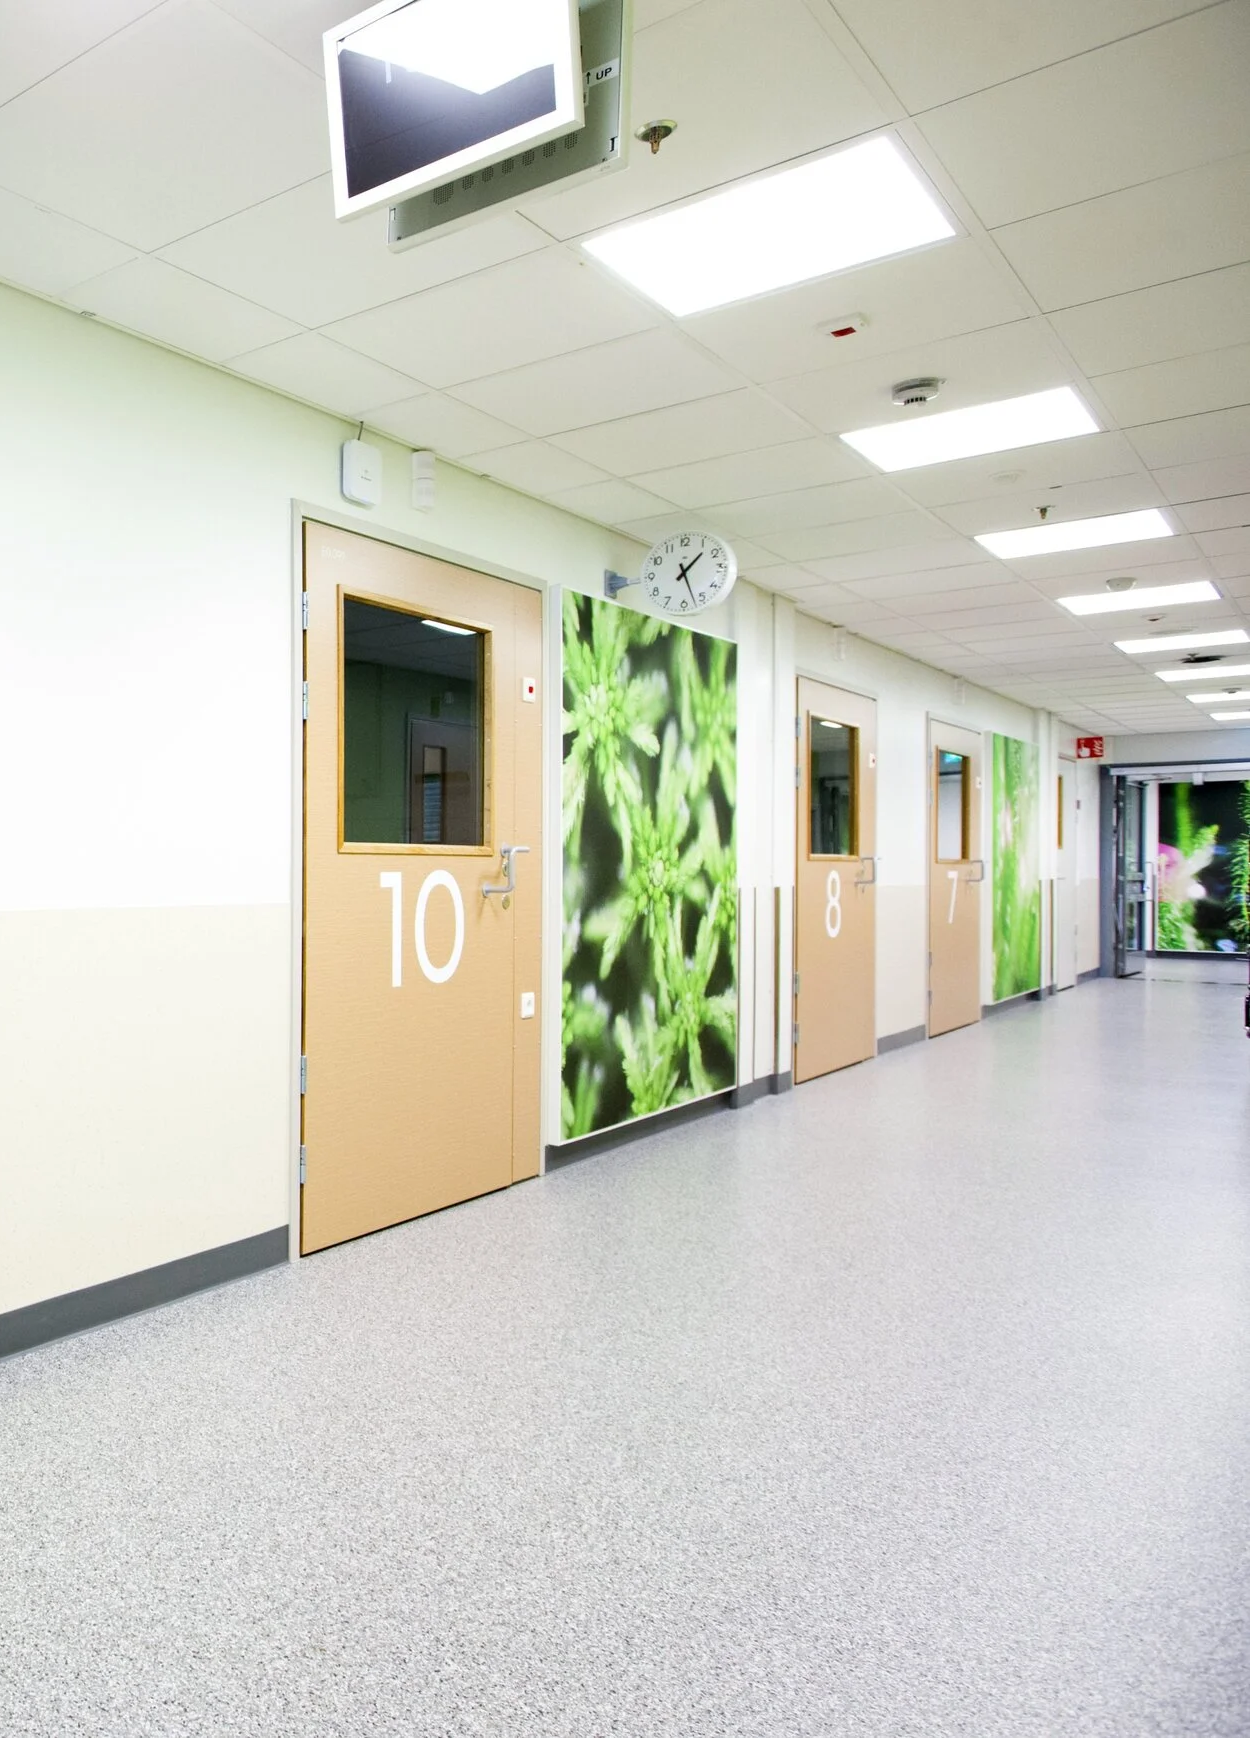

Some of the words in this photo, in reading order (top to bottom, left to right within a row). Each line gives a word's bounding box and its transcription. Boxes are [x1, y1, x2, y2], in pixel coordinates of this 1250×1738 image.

[596, 67, 612, 80] UP
[680, 537, 690, 547] 12
[701, 539, 705, 548] 1
[665, 544, 674, 554] 11
[711, 548, 719, 558] 2
[653, 556, 663, 566] 10
[648, 572, 656, 581] 9
[652, 586, 660, 596] 8
[664, 596, 672, 606] 7
[698, 592, 706, 601] 5
[680, 599, 689, 608] 6
[947, 870, 958, 924] 7
[825, 870, 841, 938] 8
[379, 869, 465, 988] 10
